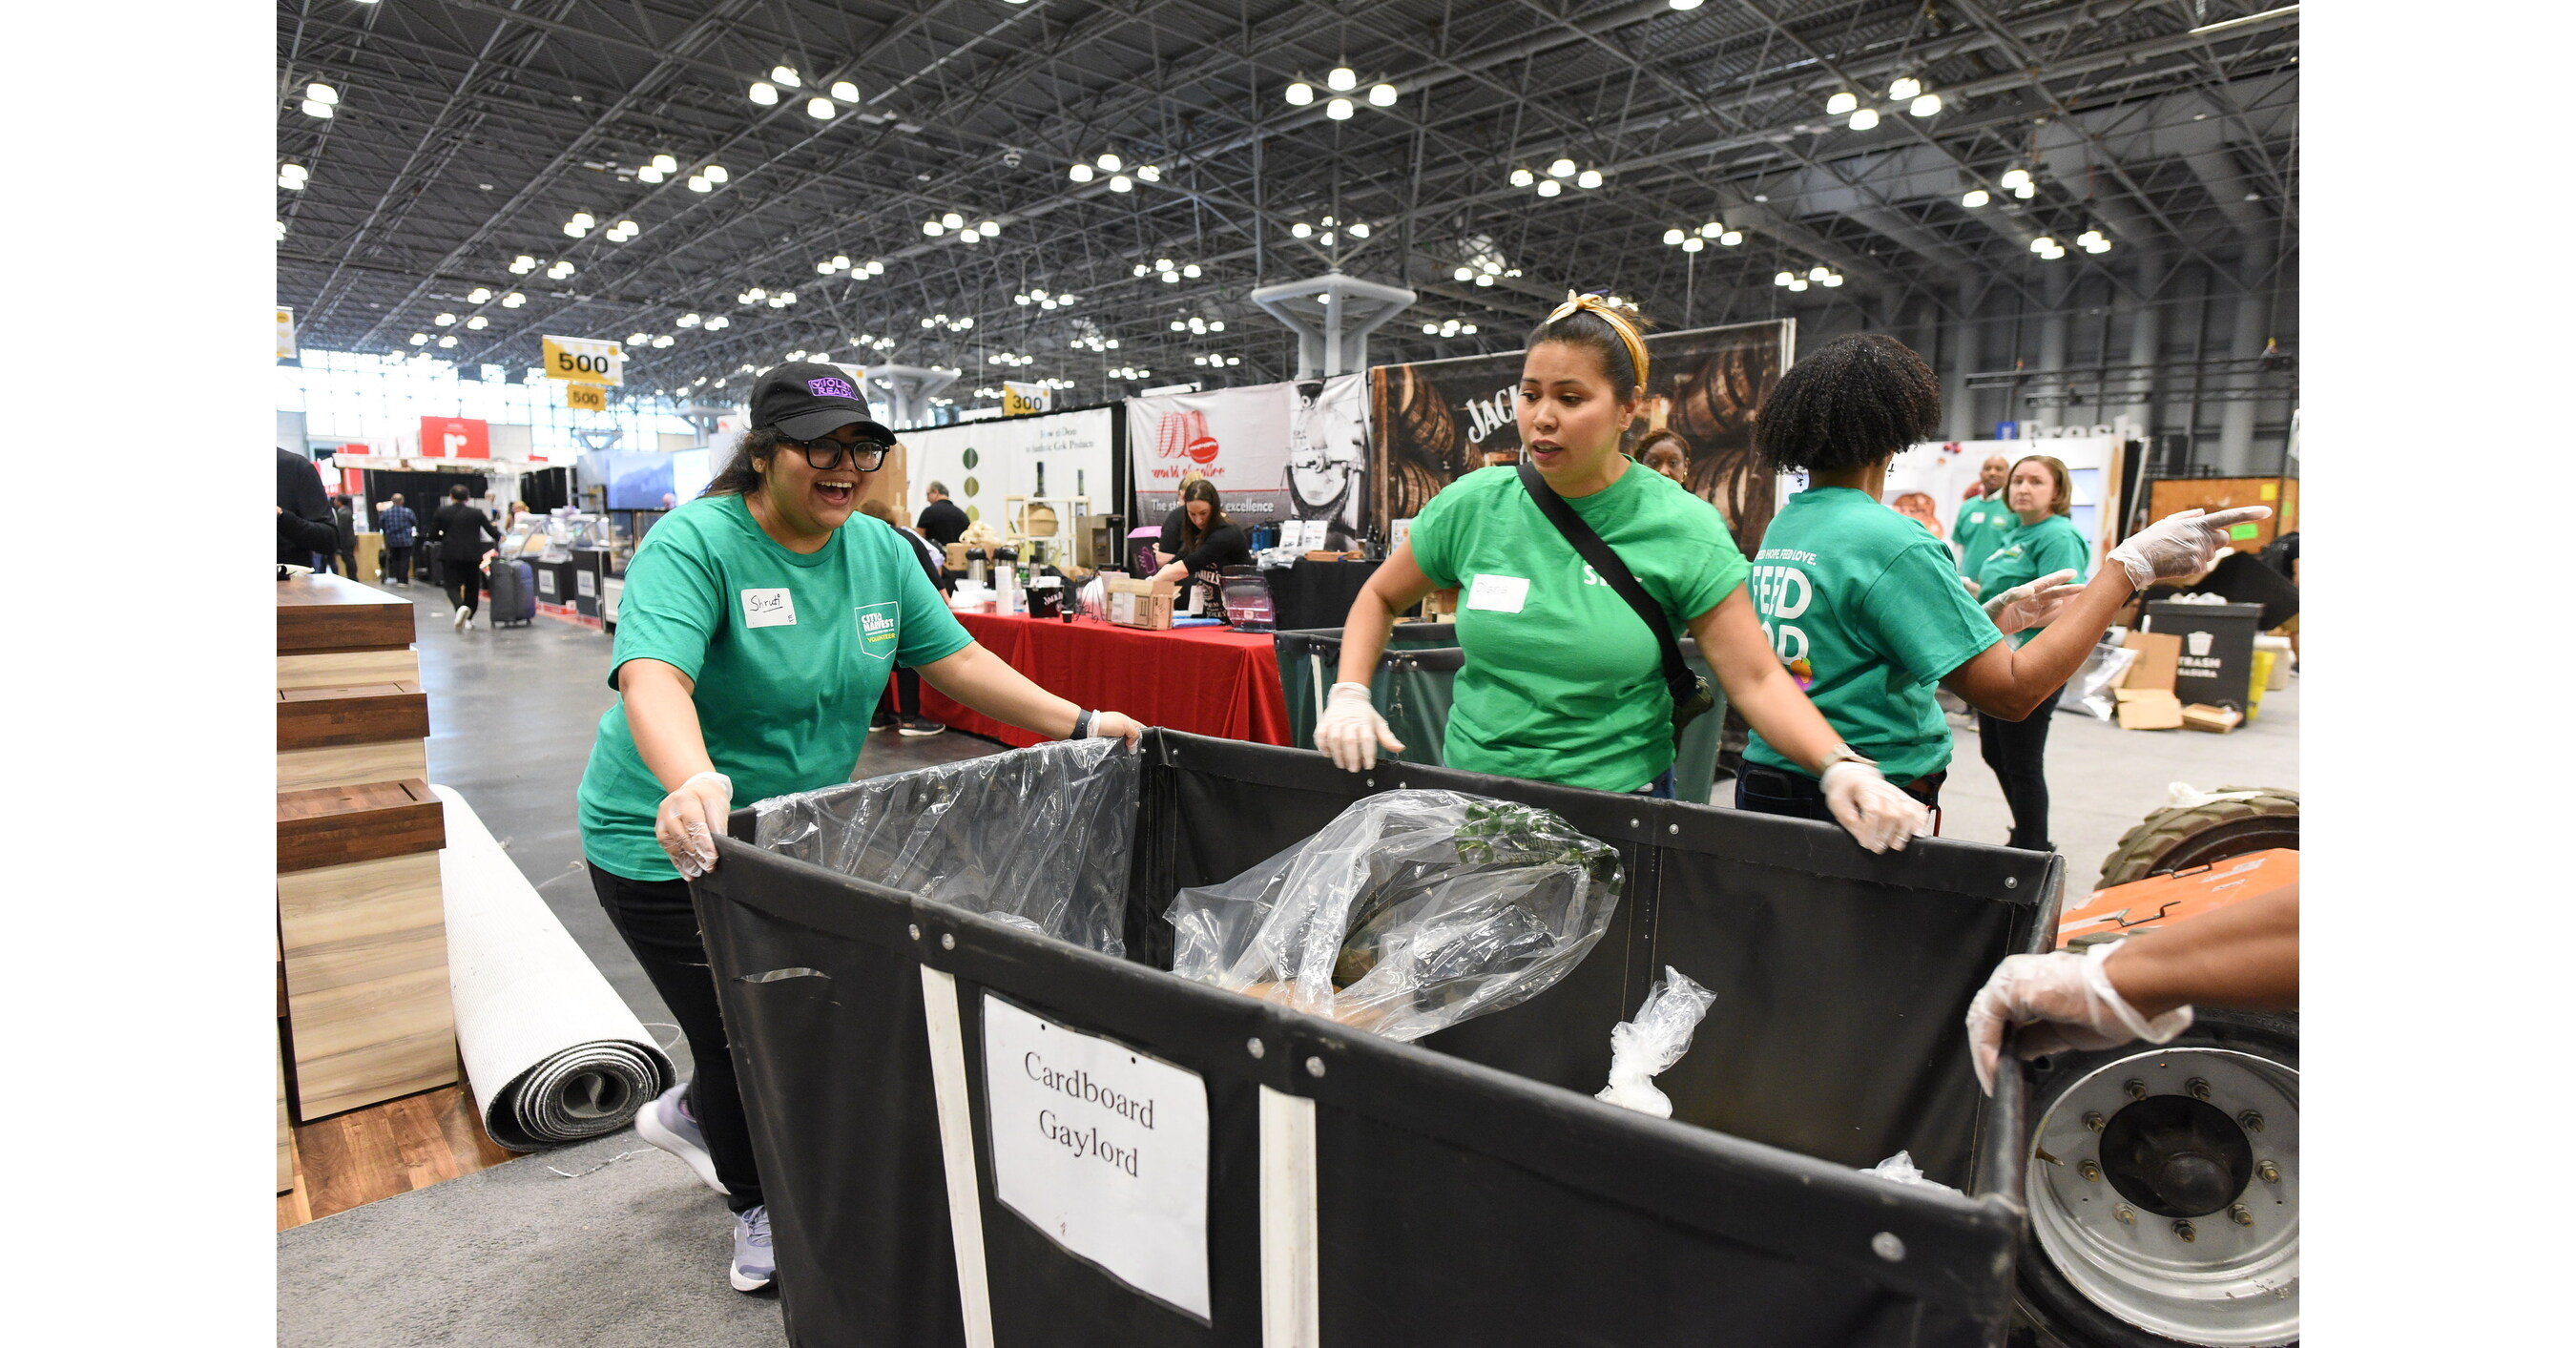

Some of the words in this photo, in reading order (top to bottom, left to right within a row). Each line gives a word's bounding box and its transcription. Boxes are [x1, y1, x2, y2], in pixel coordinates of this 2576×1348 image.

[558, 352, 609, 374] 500
[573, 390, 599, 405] 500
[818, 386, 852, 397] READY
[1012, 394, 1043, 411] 300
[1151, 498, 1167, 511] The
[1225, 497, 1275, 512] excellence
[1792, 550, 1818, 566] LOVE.
[1753, 566, 1813, 620] FEED
[750, 593, 780, 612] Shruti
[862, 613, 878, 624] CITY
[863, 619, 894, 632] HARVEST
[867, 633, 896, 643] VOLUNTEER
[1025, 1051, 1153, 1130] Cardboard
[1039, 1110, 1138, 1178] Gaylord
